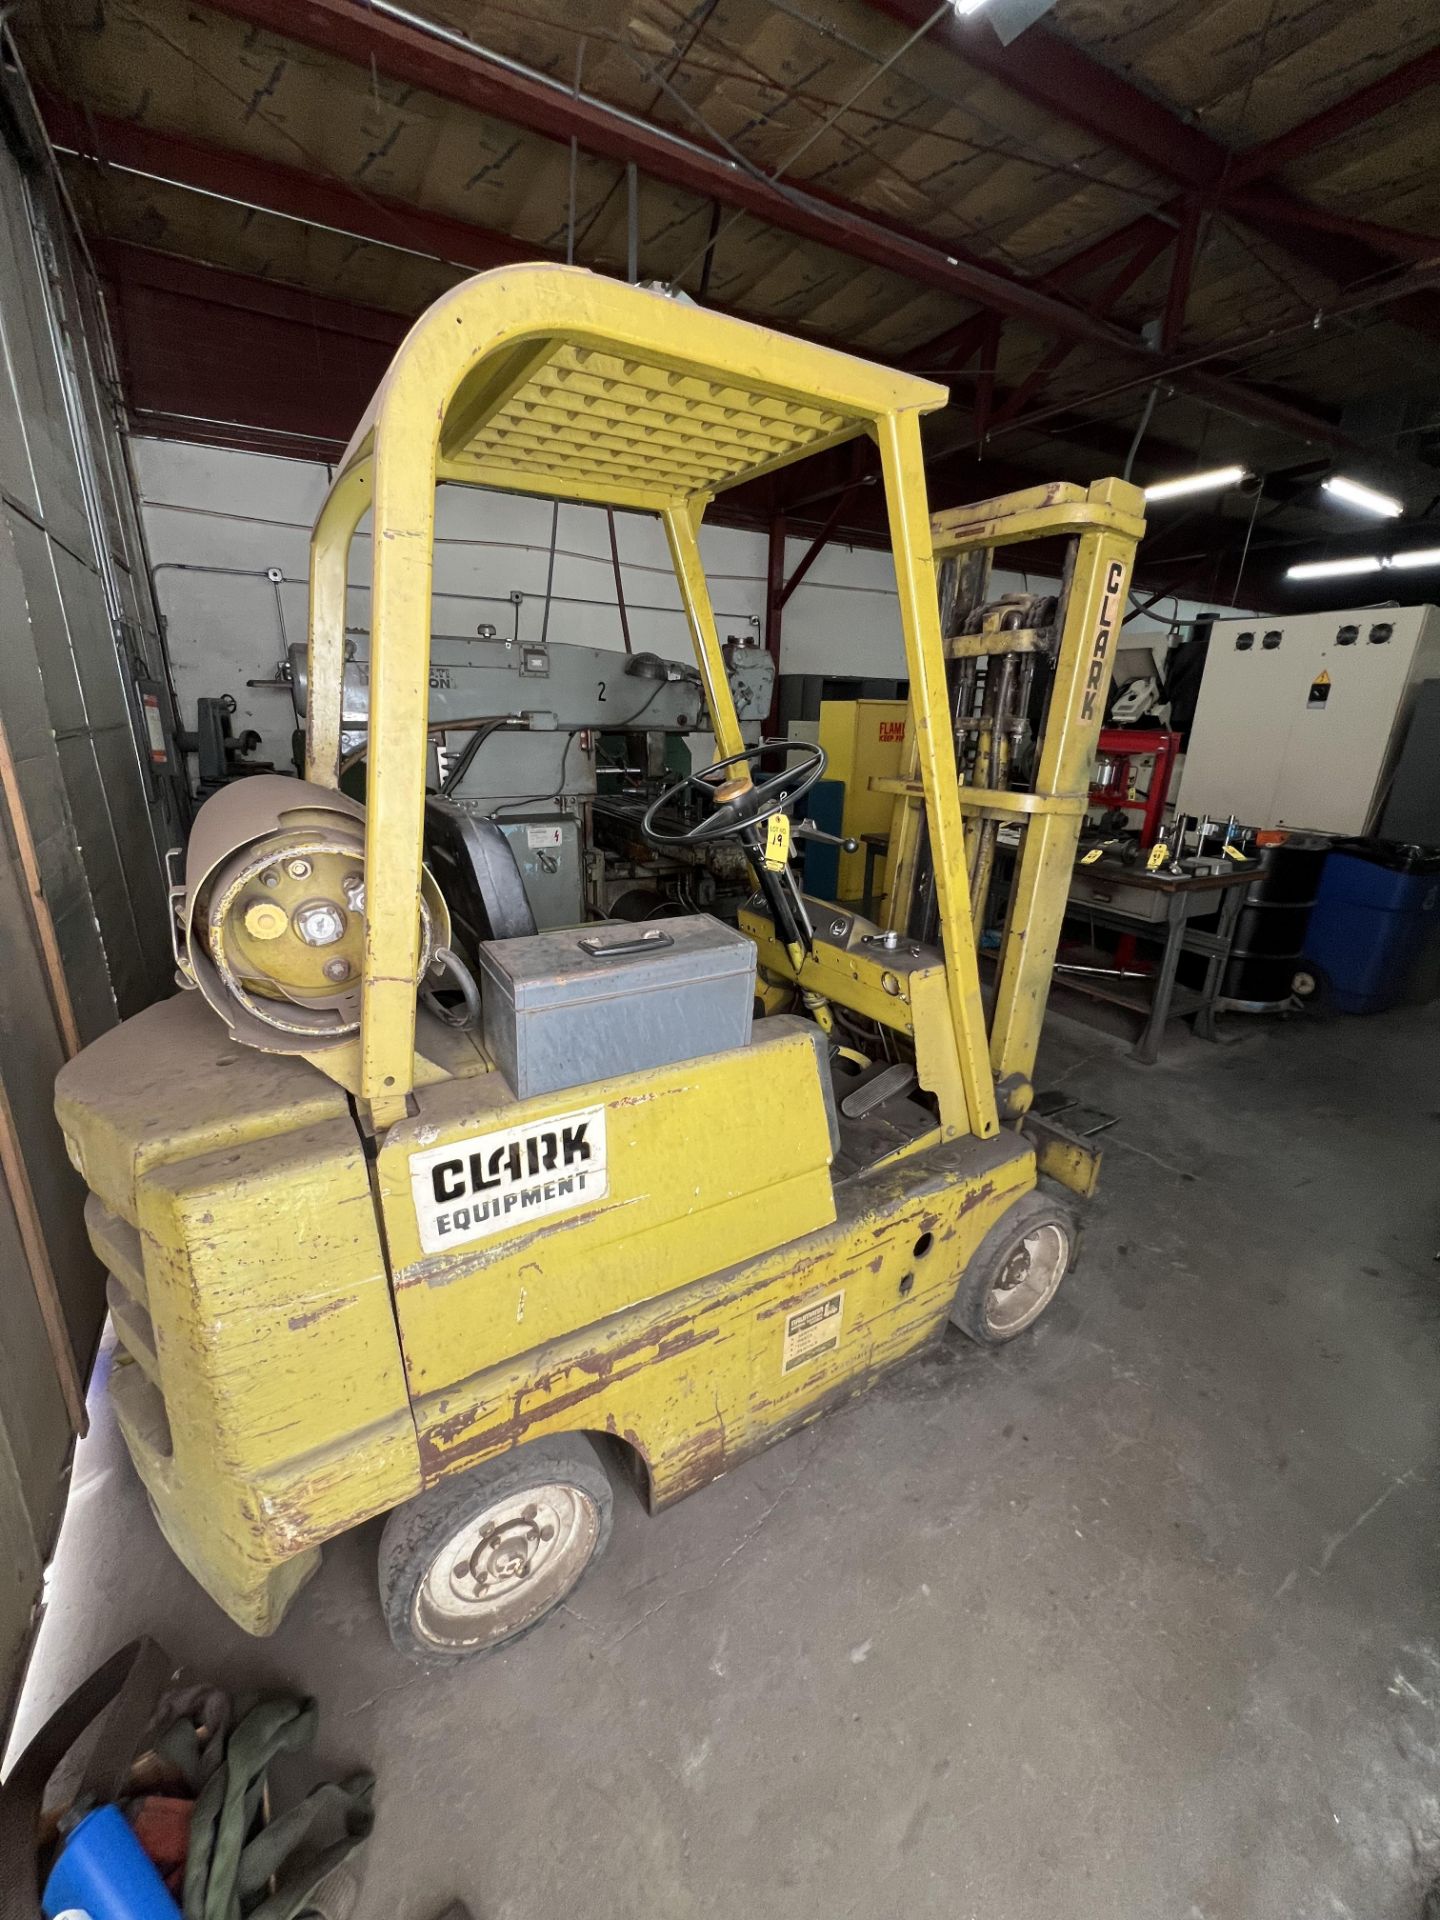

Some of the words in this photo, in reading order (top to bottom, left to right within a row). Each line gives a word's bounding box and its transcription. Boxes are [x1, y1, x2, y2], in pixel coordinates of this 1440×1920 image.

[1081, 563, 1123, 720] CLARK
[598, 681, 607, 702] 2
[880, 721, 905, 735] FLAM
[772, 833, 783, 848] 19
[431, 1120, 592, 1204] CLARK
[436, 1170, 590, 1236] EQUIPMENT
